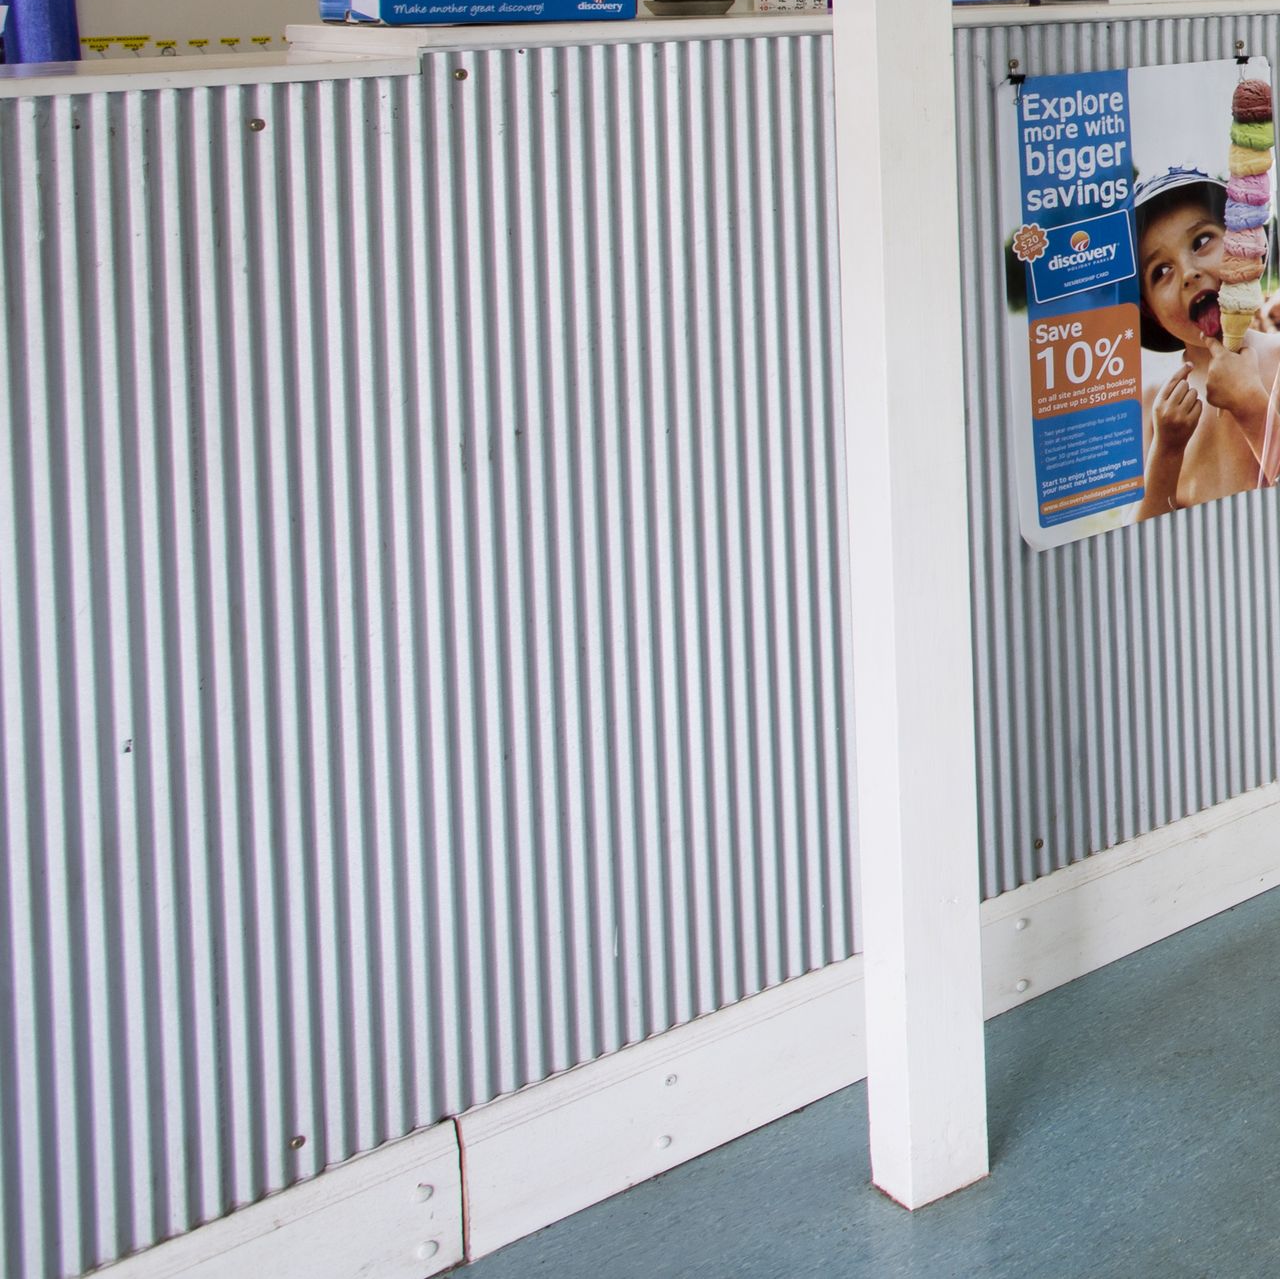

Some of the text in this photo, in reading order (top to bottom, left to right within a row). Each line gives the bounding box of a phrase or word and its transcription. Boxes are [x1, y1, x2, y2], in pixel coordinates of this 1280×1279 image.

[393, 2, 545, 16] Make another great discovery!
[577, 1, 623, 12] discovery
[1022, 90, 1124, 123] Explore
[1024, 114, 1125, 143] more with
[1026, 140, 1126, 181] bigger
[1026, 178, 1128, 211] savings
[1021, 235, 1039, 251] $20
[1048, 243, 1117, 271] discovery
[1067, 258, 1110, 272] HOLIDAY PARKS
[1064, 271, 1109, 288] MEMBERSHIP CARD
[1036, 322, 1082, 344] Save
[1038, 404, 1052, 414] and
[1052, 401, 1068, 410] save
[1070, 399, 1079, 408] up
[1089, 392, 1107, 404] $50
[1108, 390, 1120, 400] per
[1120, 386, 1136, 395] stay!
[1048, 393, 1057, 402] all
[1058, 390, 1072, 400] site
[1072, 388, 1086, 397] and
[1086, 383, 1106, 393] cabin
[1106, 378, 1136, 389] bookings
[1042, 478, 1058, 488] Start
[1068, 470, 1086, 482] enjoy
[1086, 468, 1098, 476] the
[1098, 462, 1122, 472] savings
[1122, 458, 1138, 466] from
[1042, 488, 1058, 498] your
[1058, 483, 1072, 491] next
[1088, 471, 1116, 482] booking.
[1043, 481, 1138, 512] www.discoveryholidayparks.com.au
